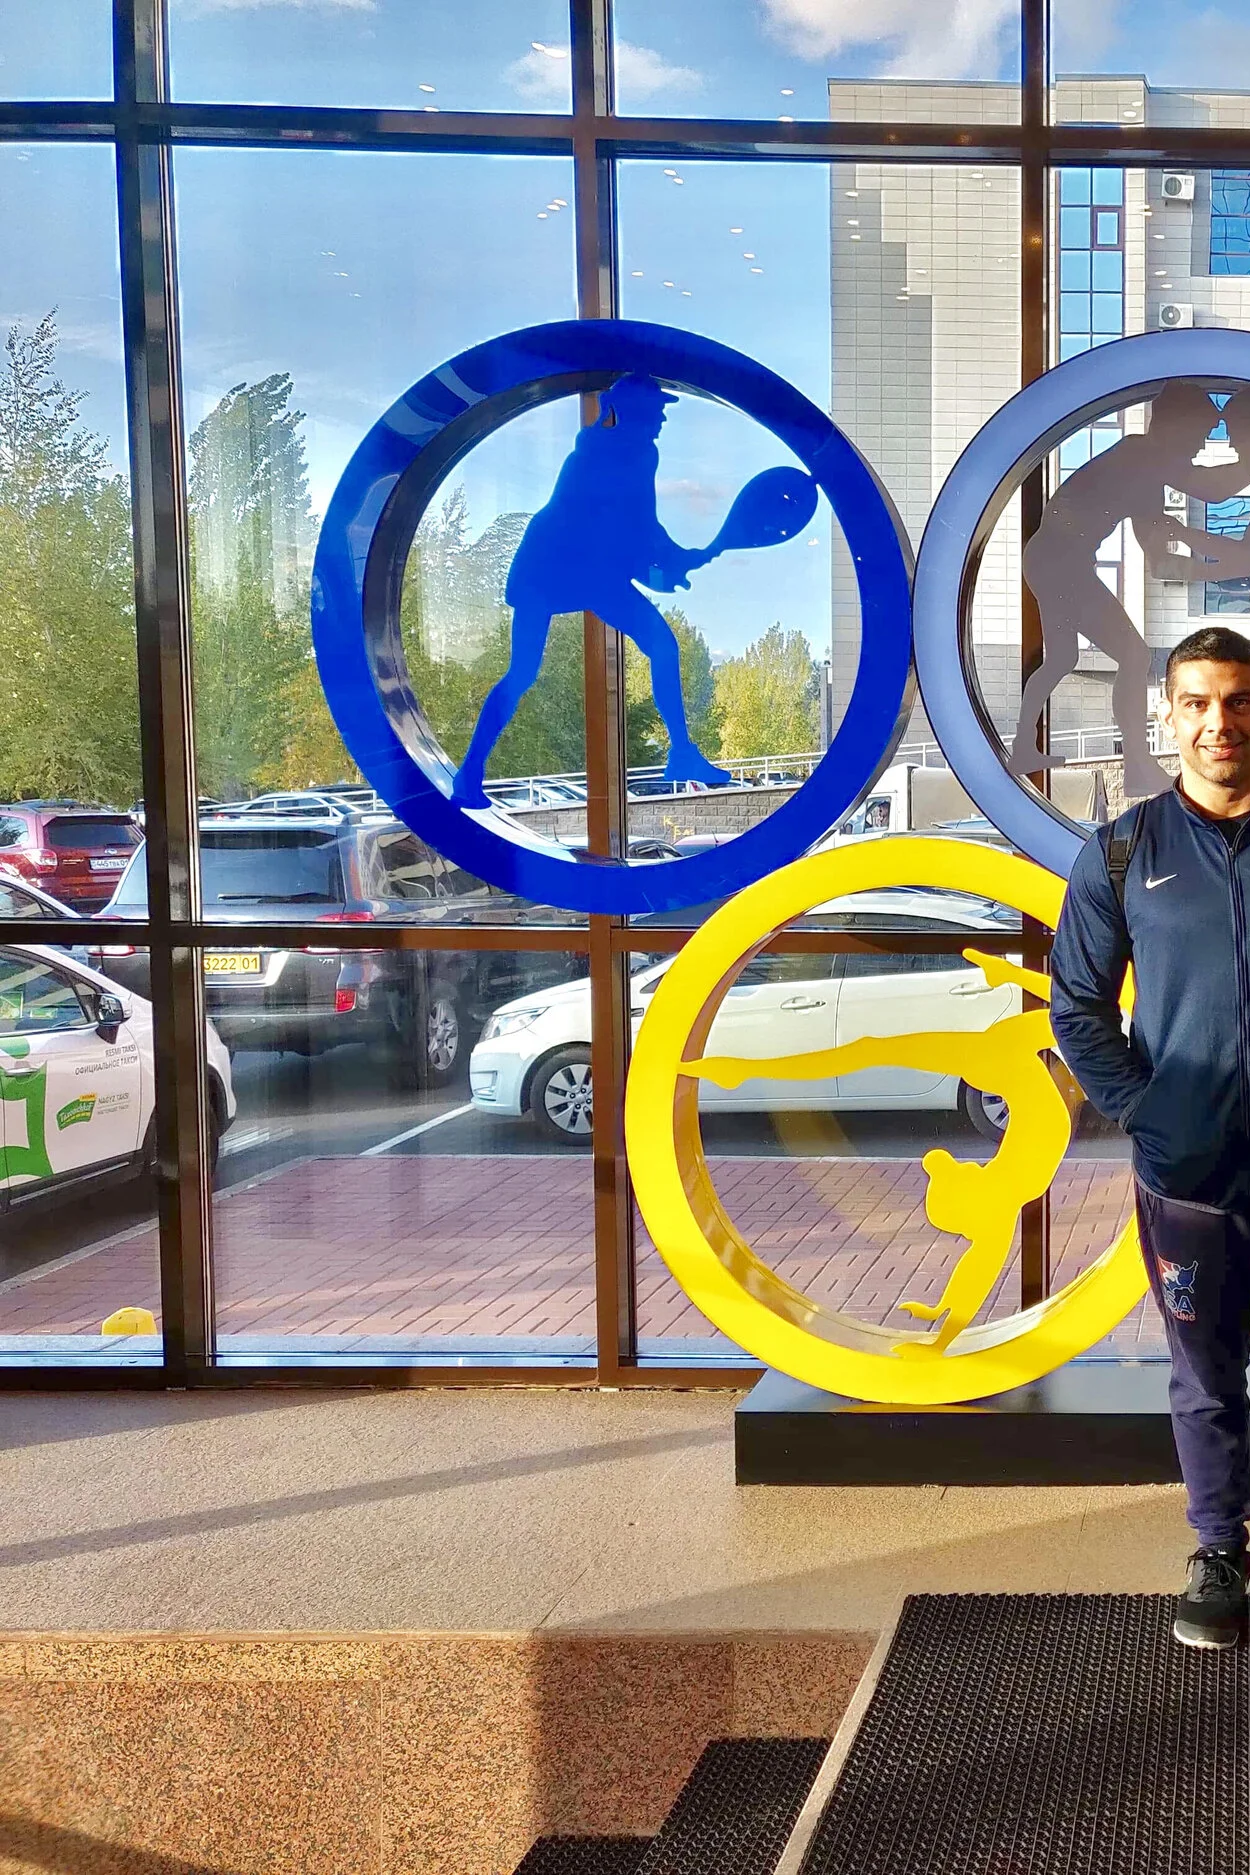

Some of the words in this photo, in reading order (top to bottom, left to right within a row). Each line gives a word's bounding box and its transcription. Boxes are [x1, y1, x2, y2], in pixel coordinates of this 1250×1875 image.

[204, 958, 237, 971] 3222
[242, 957, 259, 970] 01
[122, 1044, 136, 1053] TAKSI
[75, 1058, 120, 1075] ОФИЦИАЛЬНОЕ
